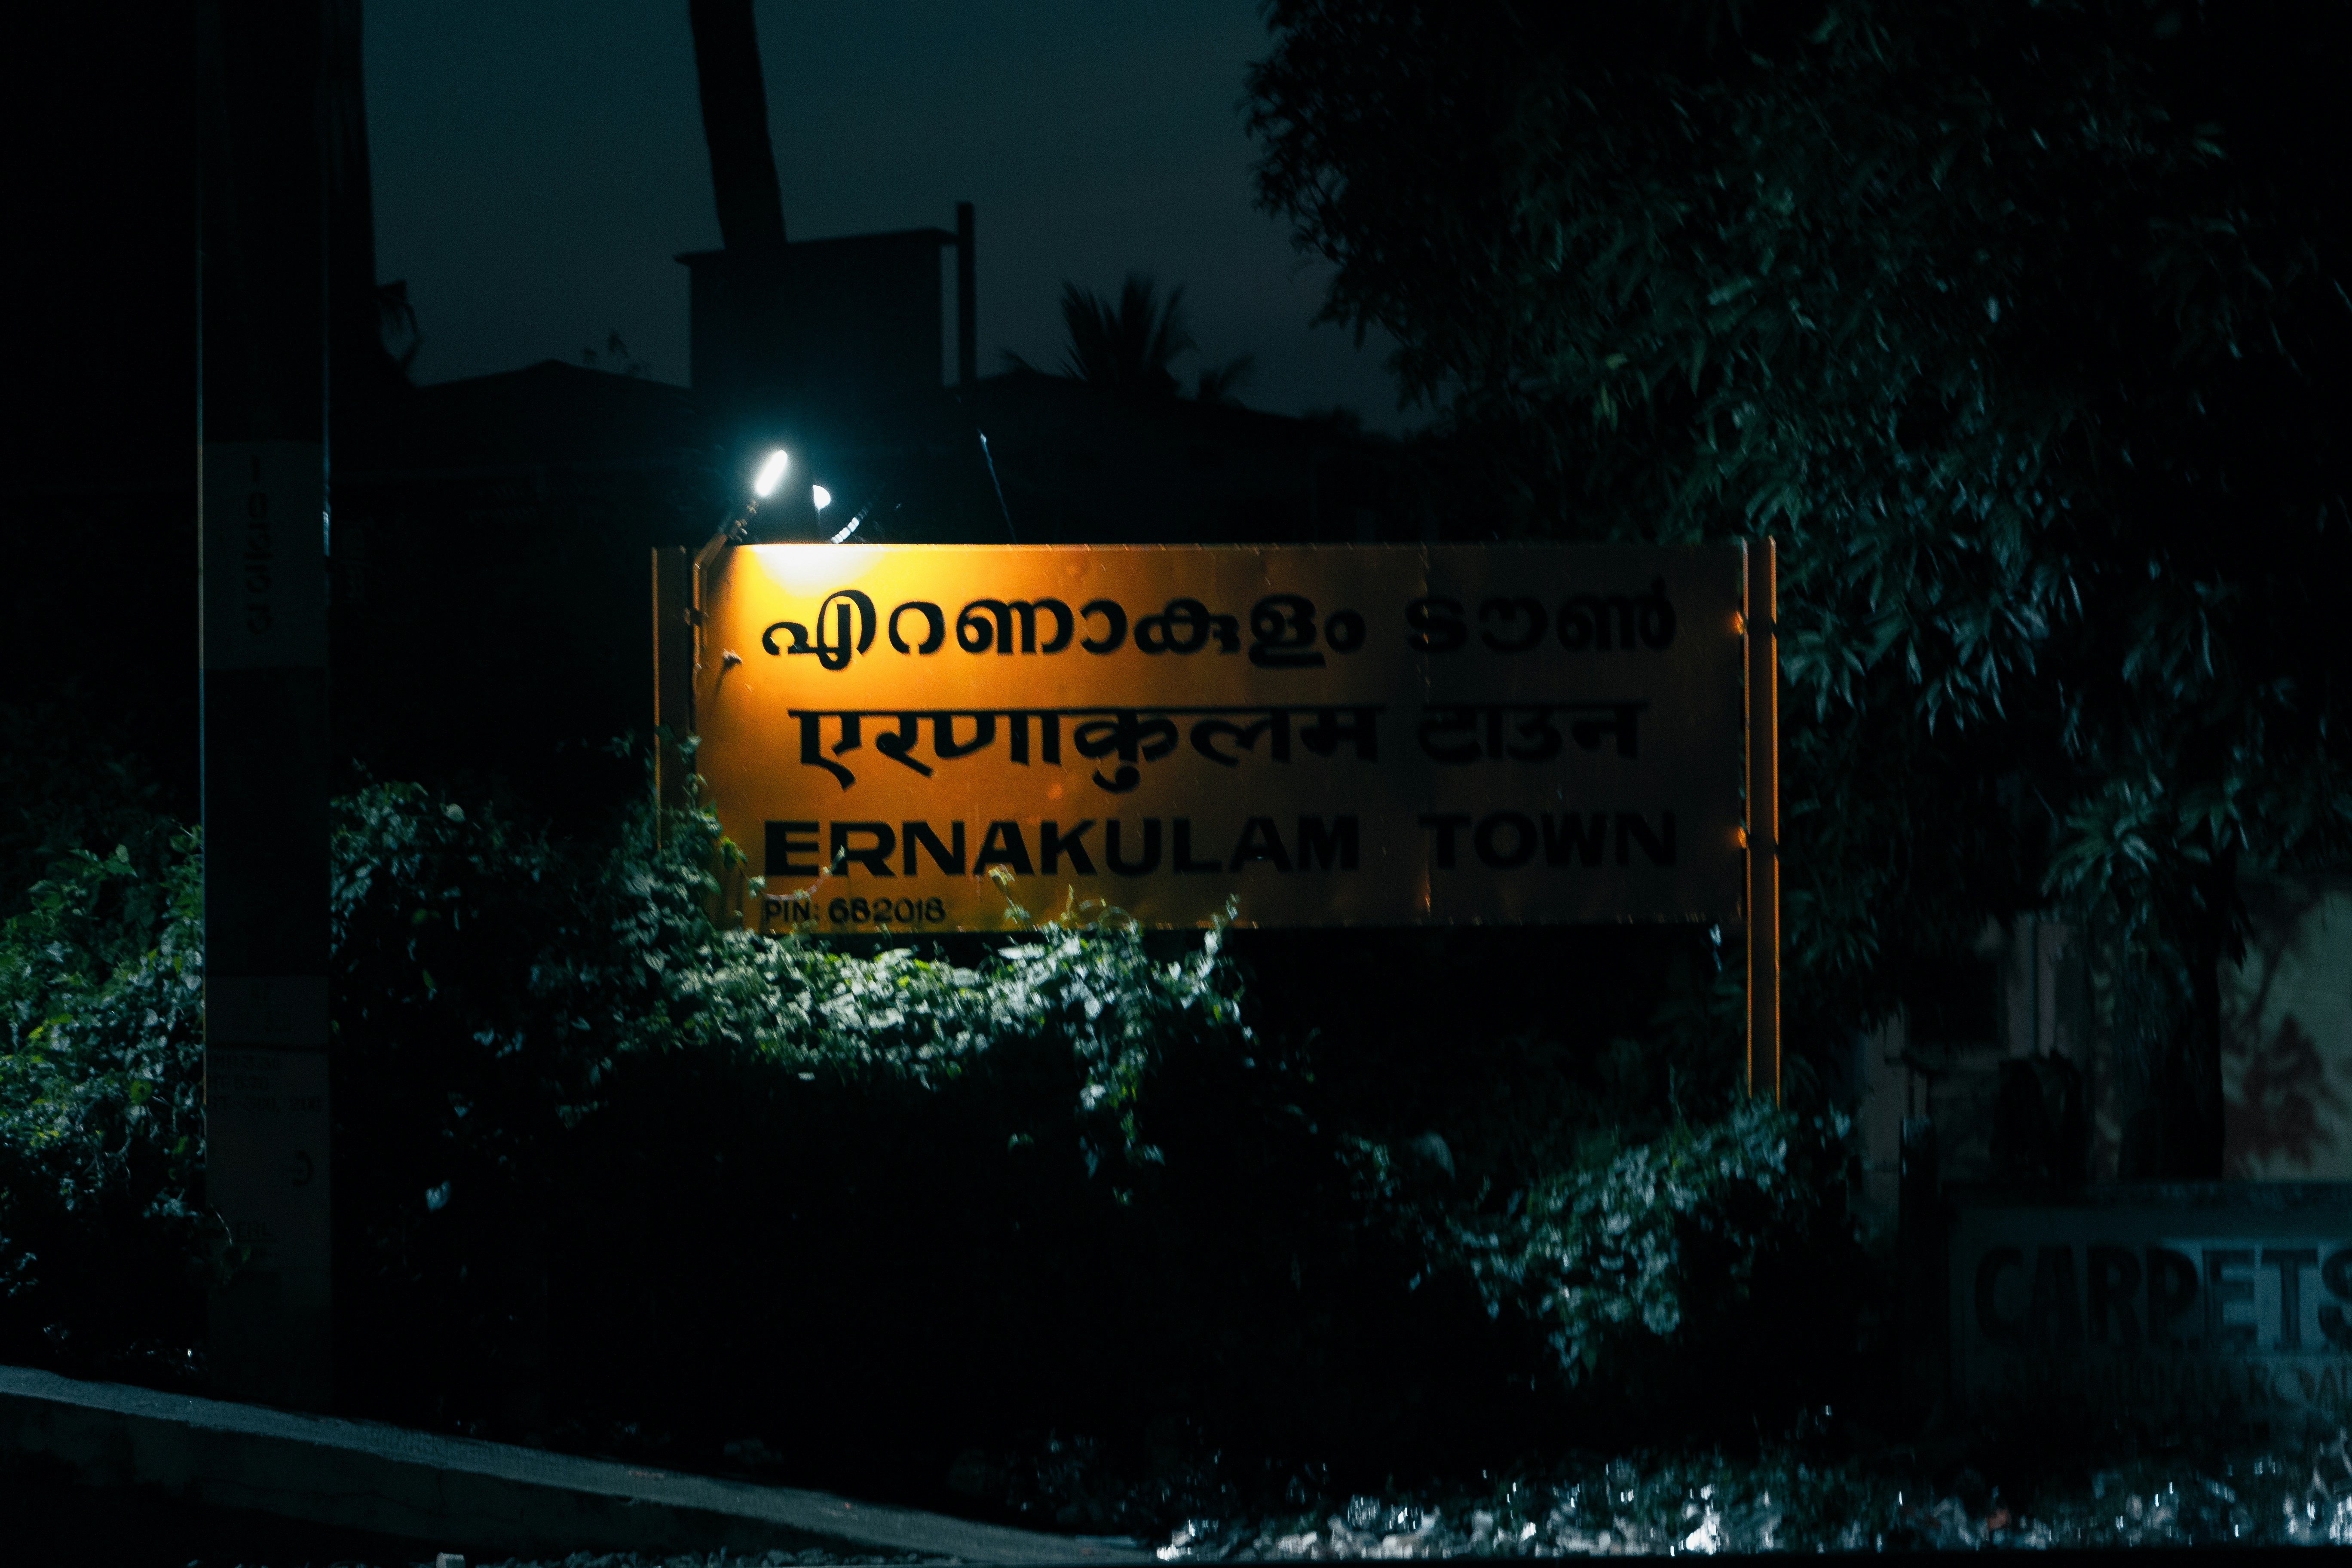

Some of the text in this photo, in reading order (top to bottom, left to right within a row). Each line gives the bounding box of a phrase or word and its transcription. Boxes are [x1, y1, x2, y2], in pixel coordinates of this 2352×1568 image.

[763, 576, 1675, 671] എറണാകുളം ടൗൺ
[788, 701, 1648, 792] एरणाकुलम टाउन
[765, 811, 1676, 878] ERNAKULAM TOWN
[827, 897, 946, 924] 682018
[1975, 1245, 2352, 1351] CARPETS
